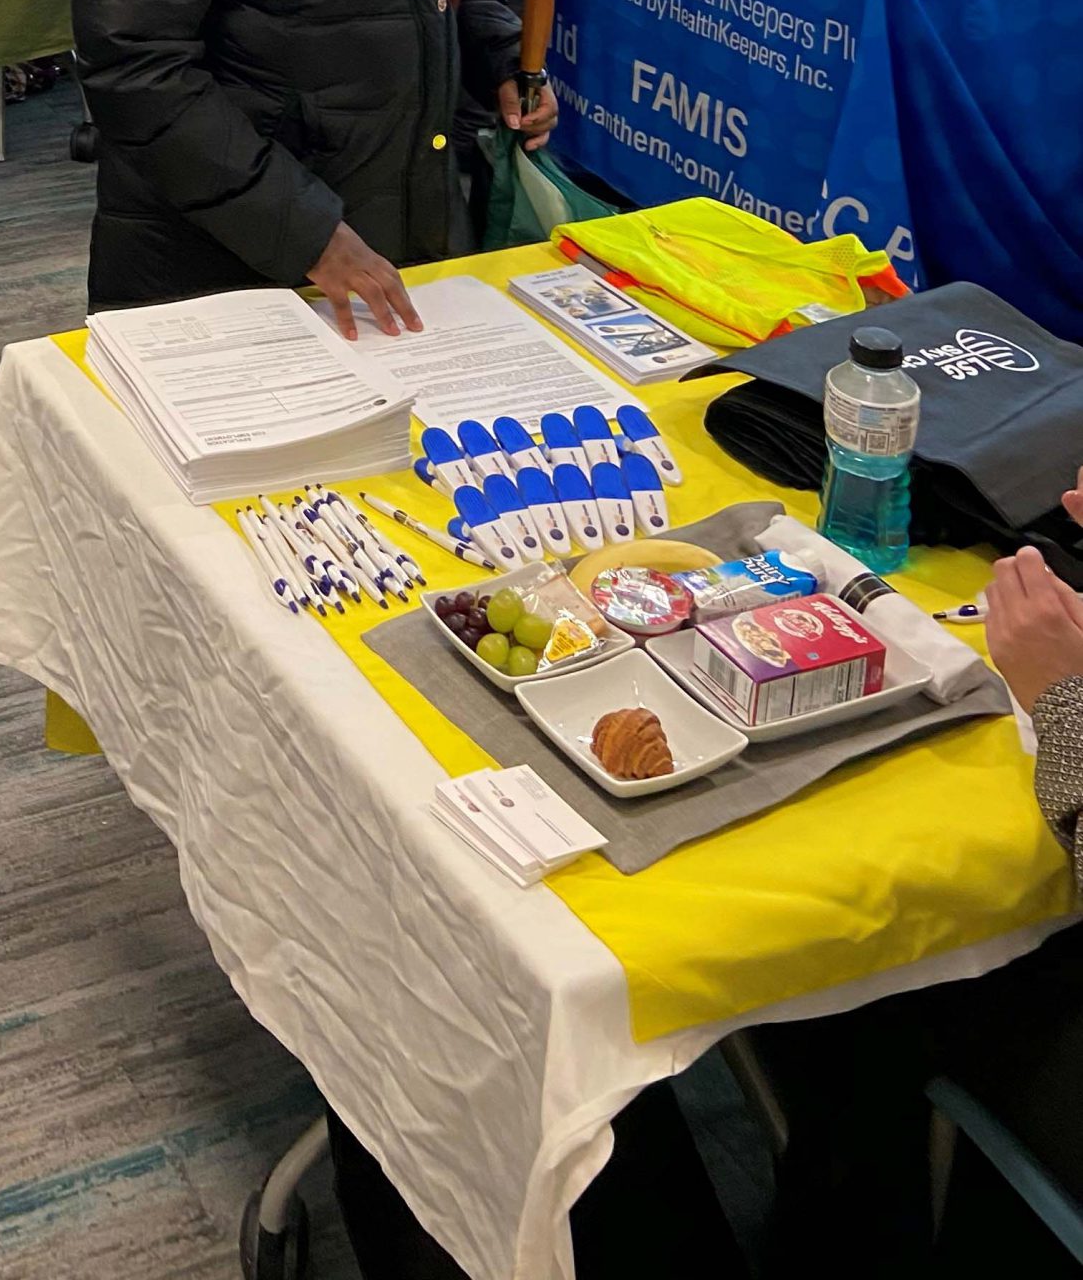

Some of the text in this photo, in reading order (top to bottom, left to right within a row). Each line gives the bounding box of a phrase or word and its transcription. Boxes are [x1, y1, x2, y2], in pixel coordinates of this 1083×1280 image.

[547, 13, 578, 65] id
[794, 54, 834, 92] Inc.
[631, 59, 749, 158] FAMIS
[919, 344, 964, 360] Sky
[940, 356, 992, 380] LSG
